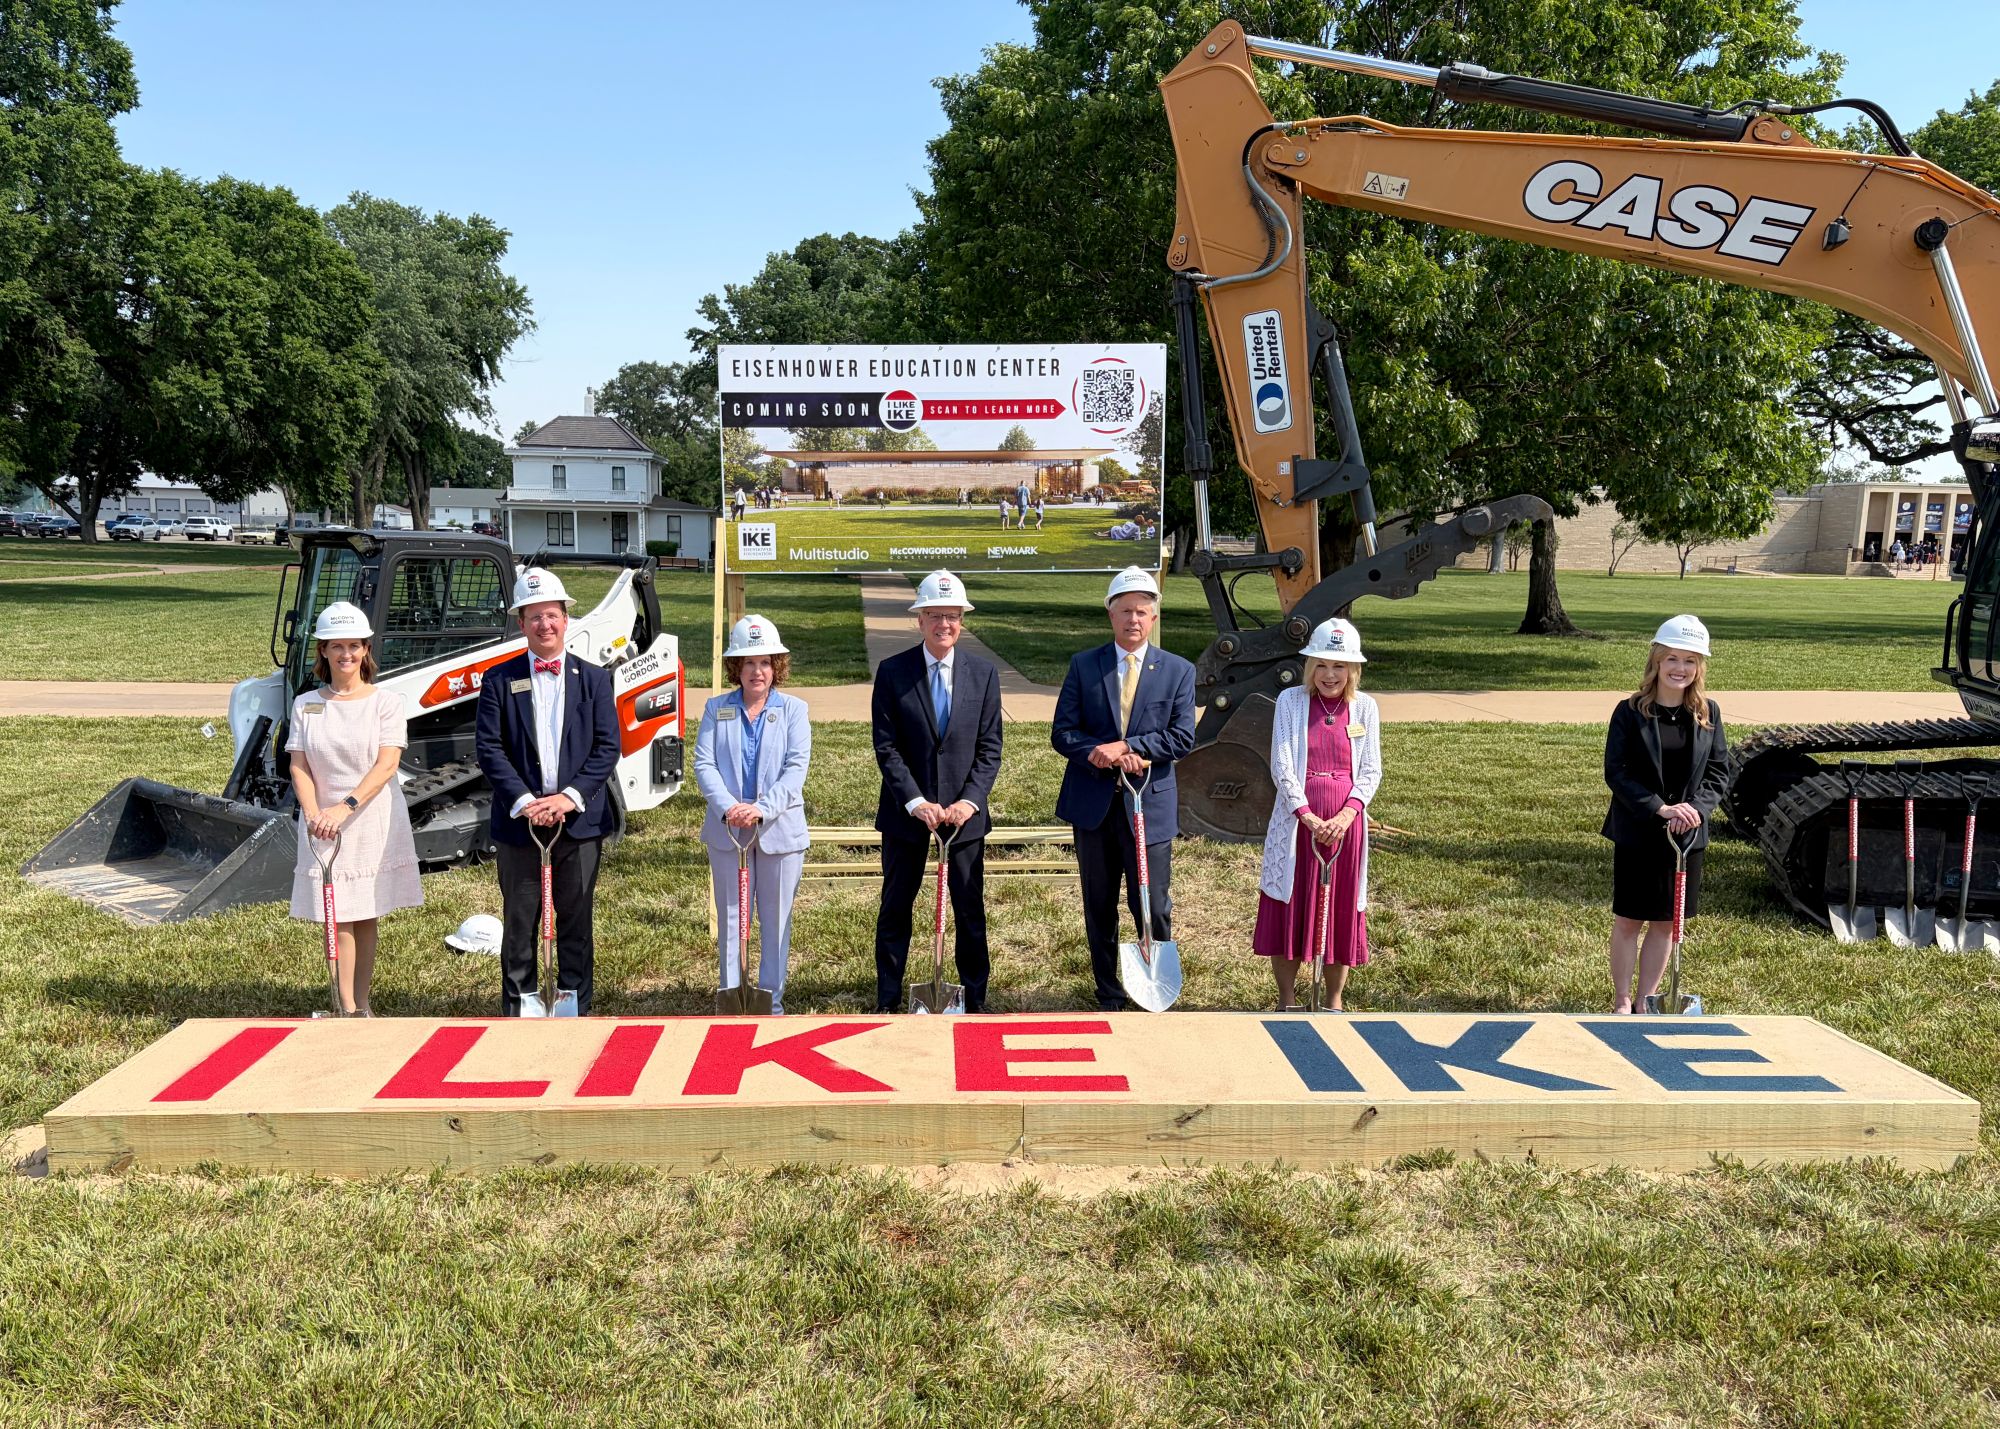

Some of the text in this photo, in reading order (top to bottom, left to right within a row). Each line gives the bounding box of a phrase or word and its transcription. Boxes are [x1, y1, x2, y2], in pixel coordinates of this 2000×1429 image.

[1522, 159, 1817, 266] CASE
[1249, 325, 1267, 381] United
[1263, 316, 1282, 378] Rentals
[733, 358, 1060, 377] EISENHOWER EDUCATION CENTER
[733, 402, 869, 416] COMING SOON
[887, 401, 916, 409] I LIKE
[930, 404, 1056, 415] SCAN TO LEARN MORE
[887, 409, 916, 420] IKE
[742, 532, 771, 547] IKE
[789, 547, 870, 561] Multistudio
[889, 547, 967, 555] McCOWNGORDON
[987, 546, 1038, 555] NEWMARK
[620, 652, 656, 676] McCOWN
[624, 661, 659, 684] GORDON
[648, 691, 673, 709] T66
[544, 867, 552, 937] McCOWNGORDON
[324, 887, 337, 958] McCOWNGORDON
[148, 1020, 1848, 1102] I LIKE IKE
